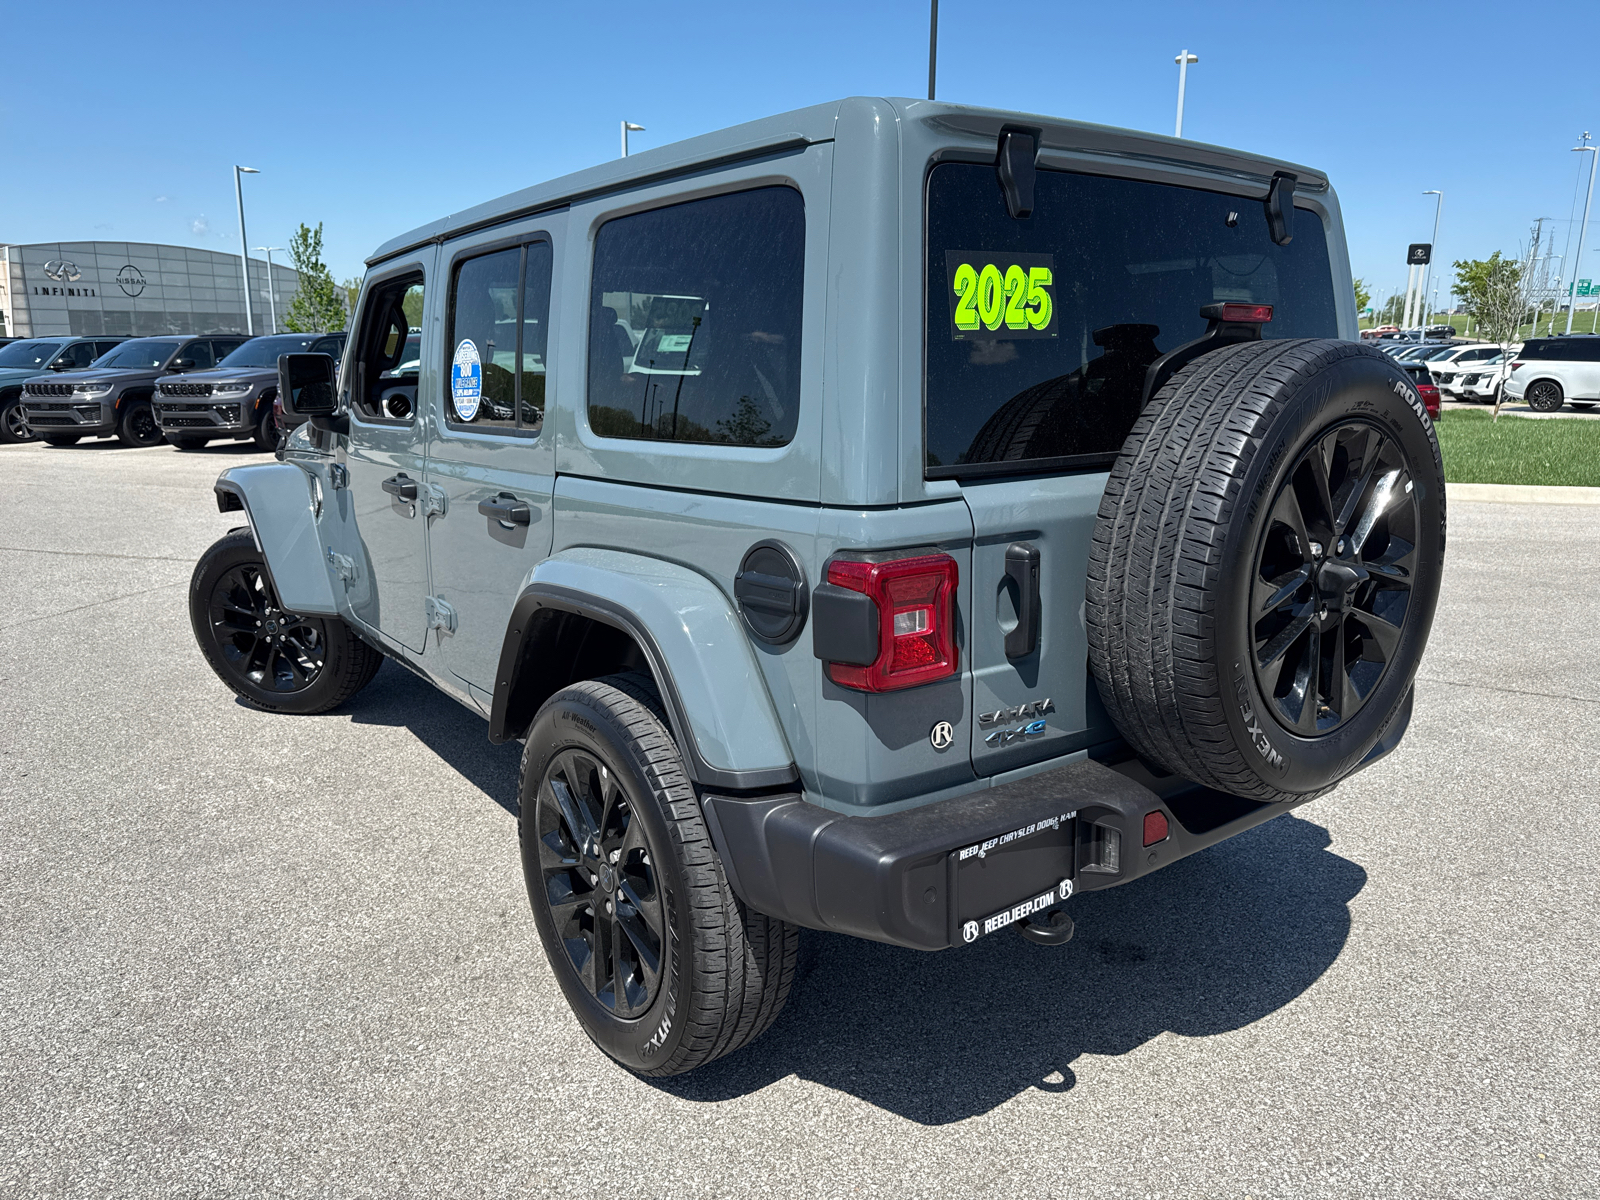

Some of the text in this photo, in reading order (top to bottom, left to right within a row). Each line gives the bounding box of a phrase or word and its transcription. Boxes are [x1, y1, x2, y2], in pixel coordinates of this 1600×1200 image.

[34, 286, 96, 297] INFINITI
[115, 277, 147, 285] NISSAN
[954, 263, 1053, 331] 2025
[1247, 438, 1286, 525] All-Weather
[561, 710, 597, 733] All-Weather
[978, 698, 1056, 726] SAHARA
[1234, 673, 1283, 768] NEXEN
[960, 844, 979, 860] REED
[979, 838, 999, 855] JEEP
[999, 823, 1036, 845] CHRYSLER
[984, 891, 1054, 934] REEDJEEP.COM
